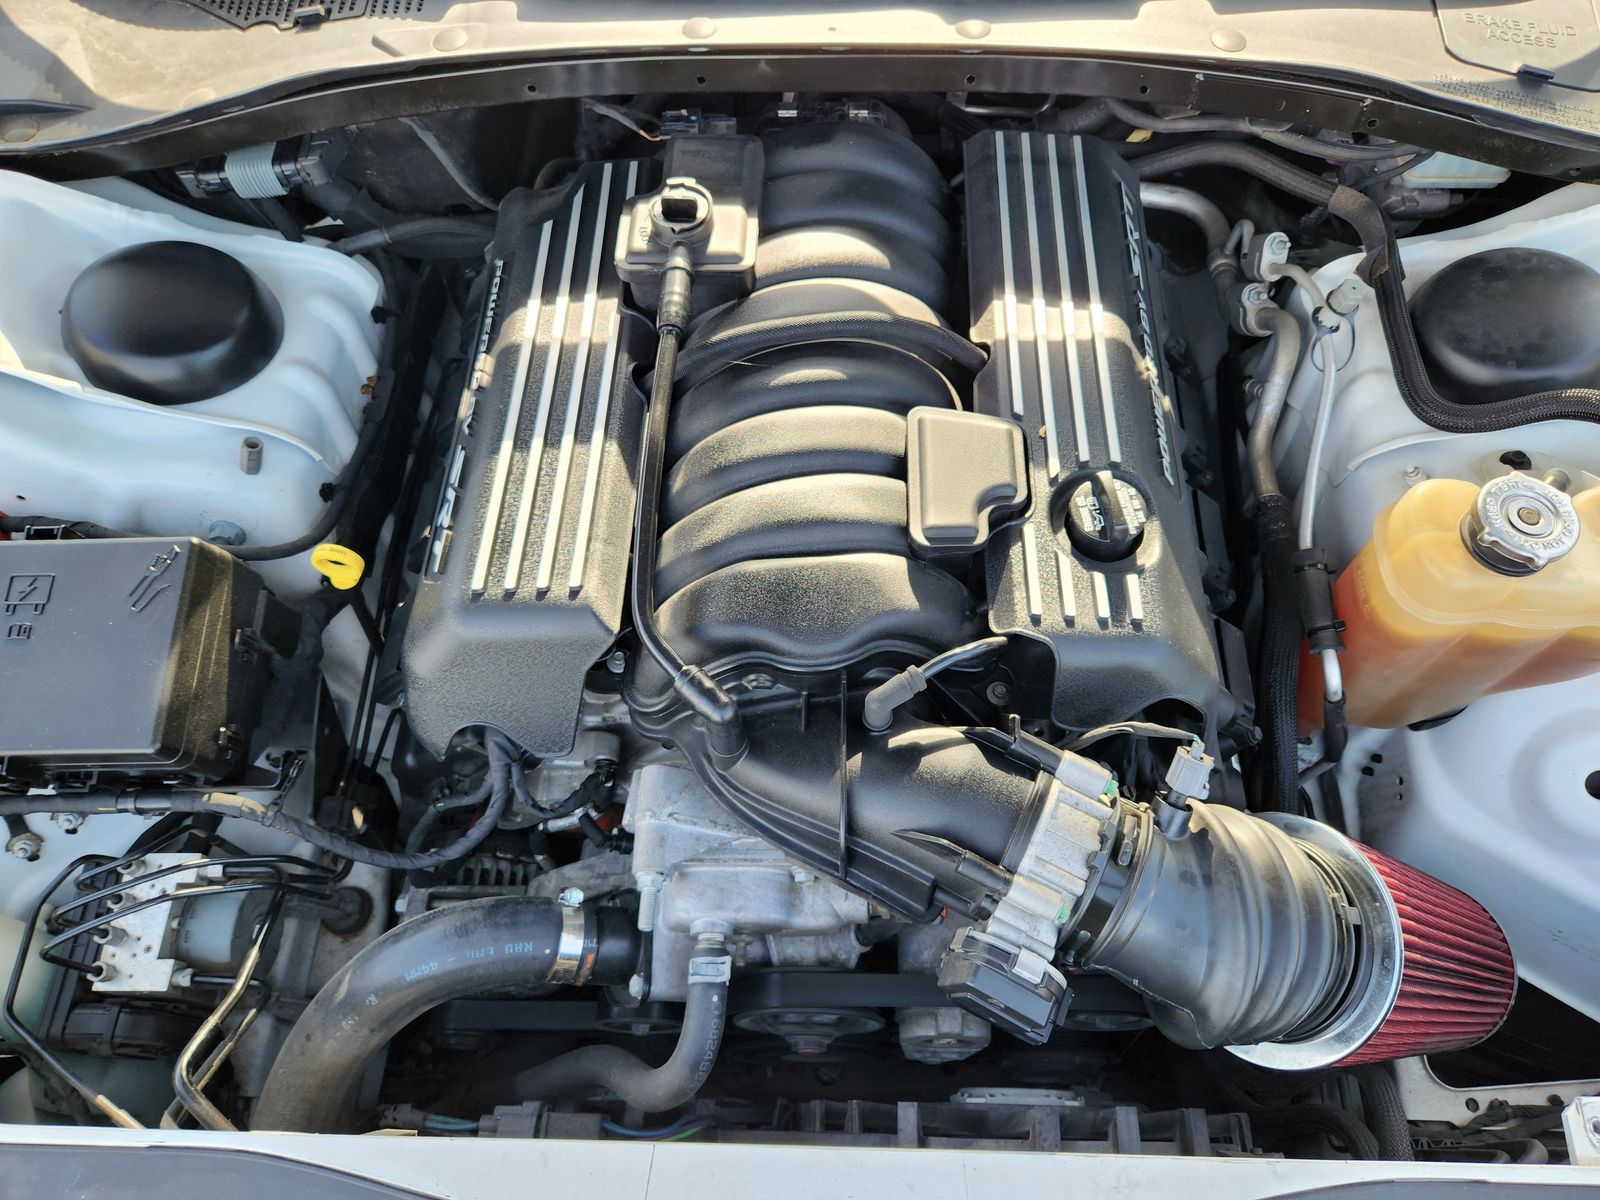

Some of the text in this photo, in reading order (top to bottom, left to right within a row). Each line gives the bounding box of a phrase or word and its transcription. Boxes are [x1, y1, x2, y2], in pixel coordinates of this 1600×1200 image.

[1464, 12, 1577, 37] BRAKE FLUID
[1487, 29, 1557, 49] ACCESS
